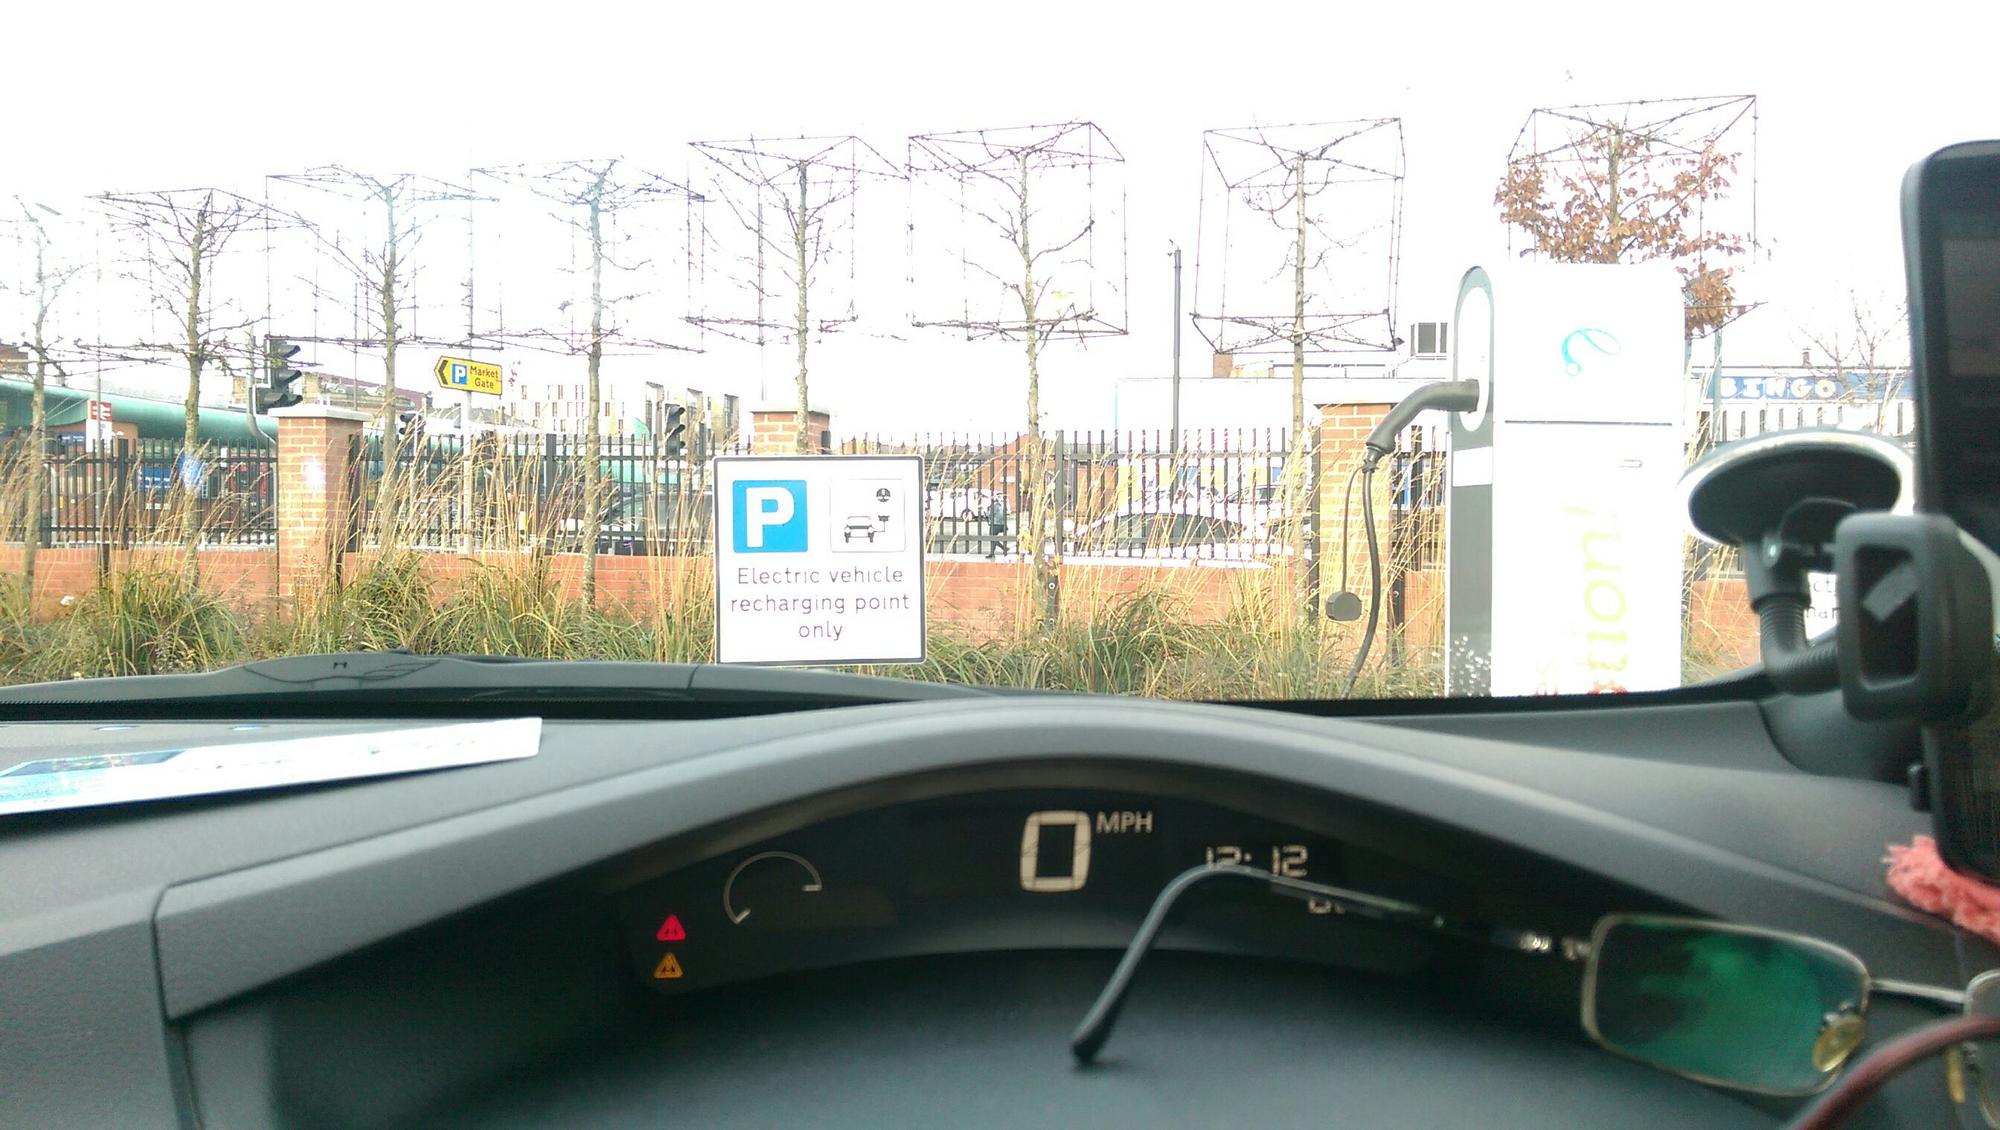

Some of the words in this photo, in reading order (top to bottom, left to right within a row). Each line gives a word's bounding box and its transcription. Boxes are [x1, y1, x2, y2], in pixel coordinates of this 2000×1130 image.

[454, 365, 466, 383] P
[470, 365, 499, 379] Market
[474, 378, 494, 389] Gate
[1720, 378, 1837, 398] BINGO
[746, 487, 795, 548] P
[737, 566, 820, 585] Electric
[829, 566, 903, 584] vehicle
[731, 594, 846, 614] recharging
[855, 593, 910, 613] point
[798, 621, 843, 641] only
[1020, 810, 1091, 892] 0
[1096, 811, 1153, 834] MPH
